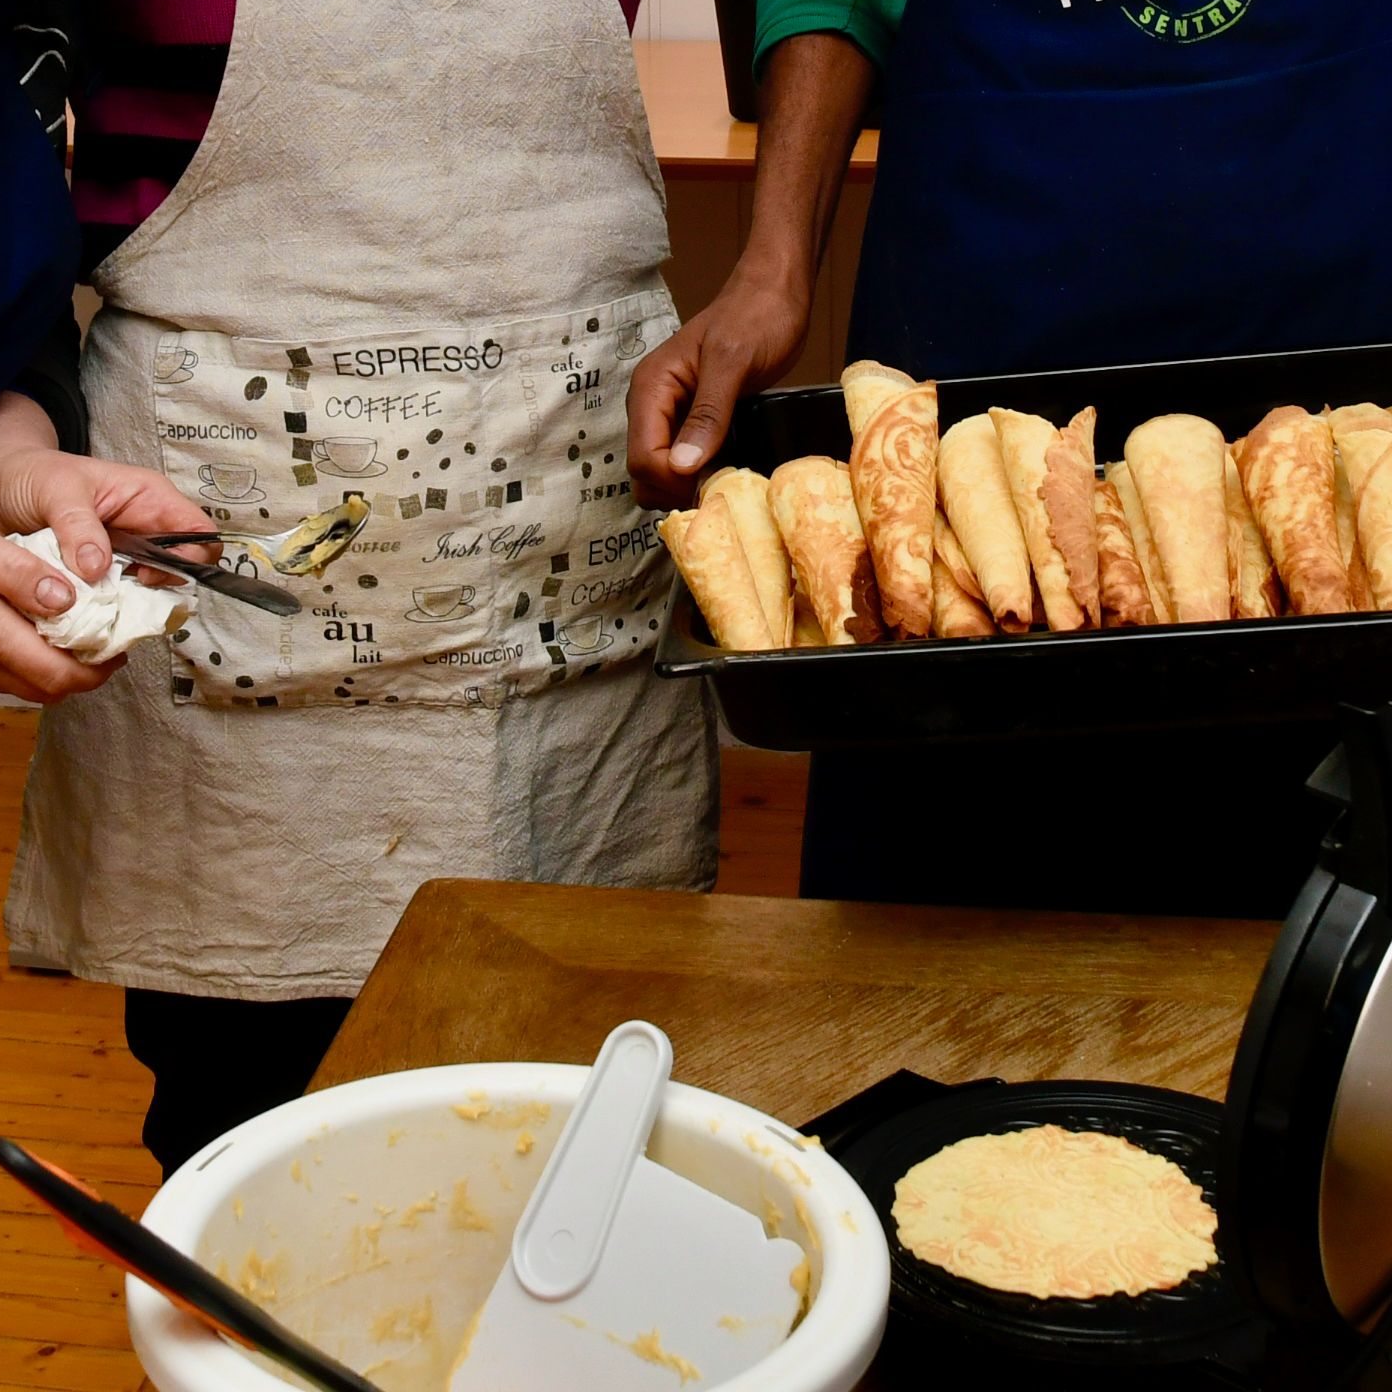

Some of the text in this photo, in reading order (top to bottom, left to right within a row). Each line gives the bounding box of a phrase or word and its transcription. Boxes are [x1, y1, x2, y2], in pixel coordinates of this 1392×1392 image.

[333, 342, 503, 377] ESPRESSO
[551, 352, 583, 373] cafe
[566, 368, 600, 394] au
[326, 391, 442, 423] COFFEE
[584, 392, 602, 410] lait
[422, 523, 546, 563] Irish Coffee
[312, 602, 348, 619] cafe
[324, 620, 377, 643] au
[352, 645, 383, 663] lait
